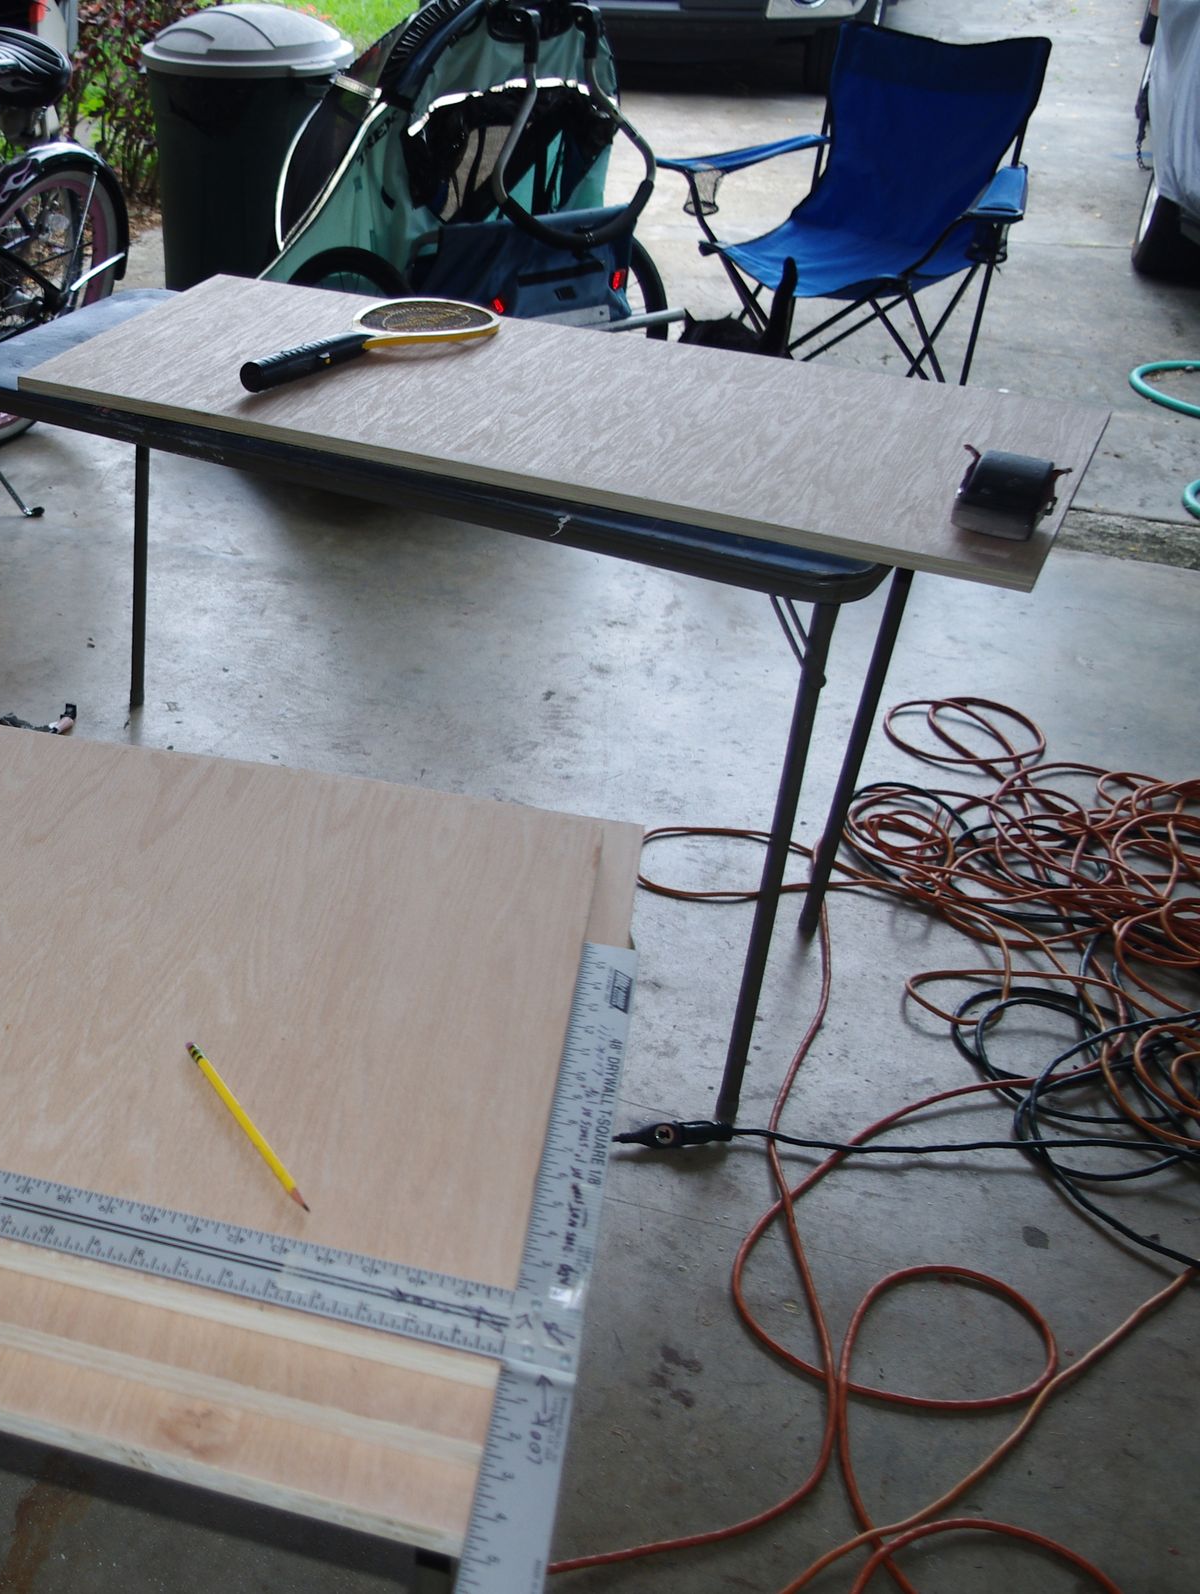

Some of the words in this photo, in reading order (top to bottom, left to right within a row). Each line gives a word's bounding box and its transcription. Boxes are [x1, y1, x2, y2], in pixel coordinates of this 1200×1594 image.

[357, 110, 398, 166] TREK
[599, 1056, 620, 1106] DRYWALL
[589, 1108, 612, 1166] T-SQUARE
[527, 1411, 553, 1466] LOOK
